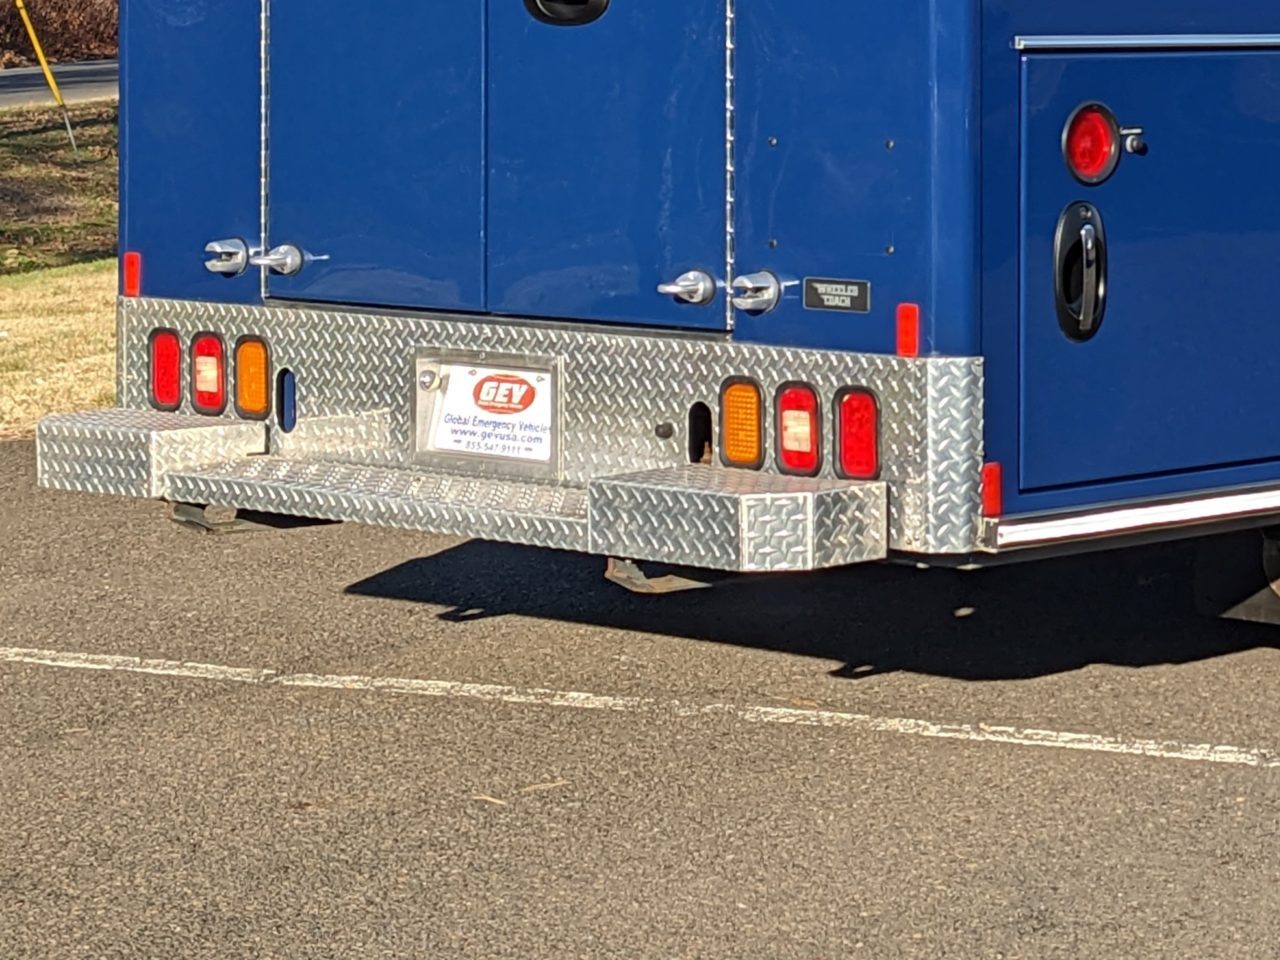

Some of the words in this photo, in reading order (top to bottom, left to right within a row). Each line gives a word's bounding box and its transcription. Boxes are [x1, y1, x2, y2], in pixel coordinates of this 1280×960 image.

[480, 381, 529, 404] GEV
[444, 412, 470, 426] Global
[472, 416, 516, 433] Emergency
[450, 427, 543, 445] www.gevusa.com
